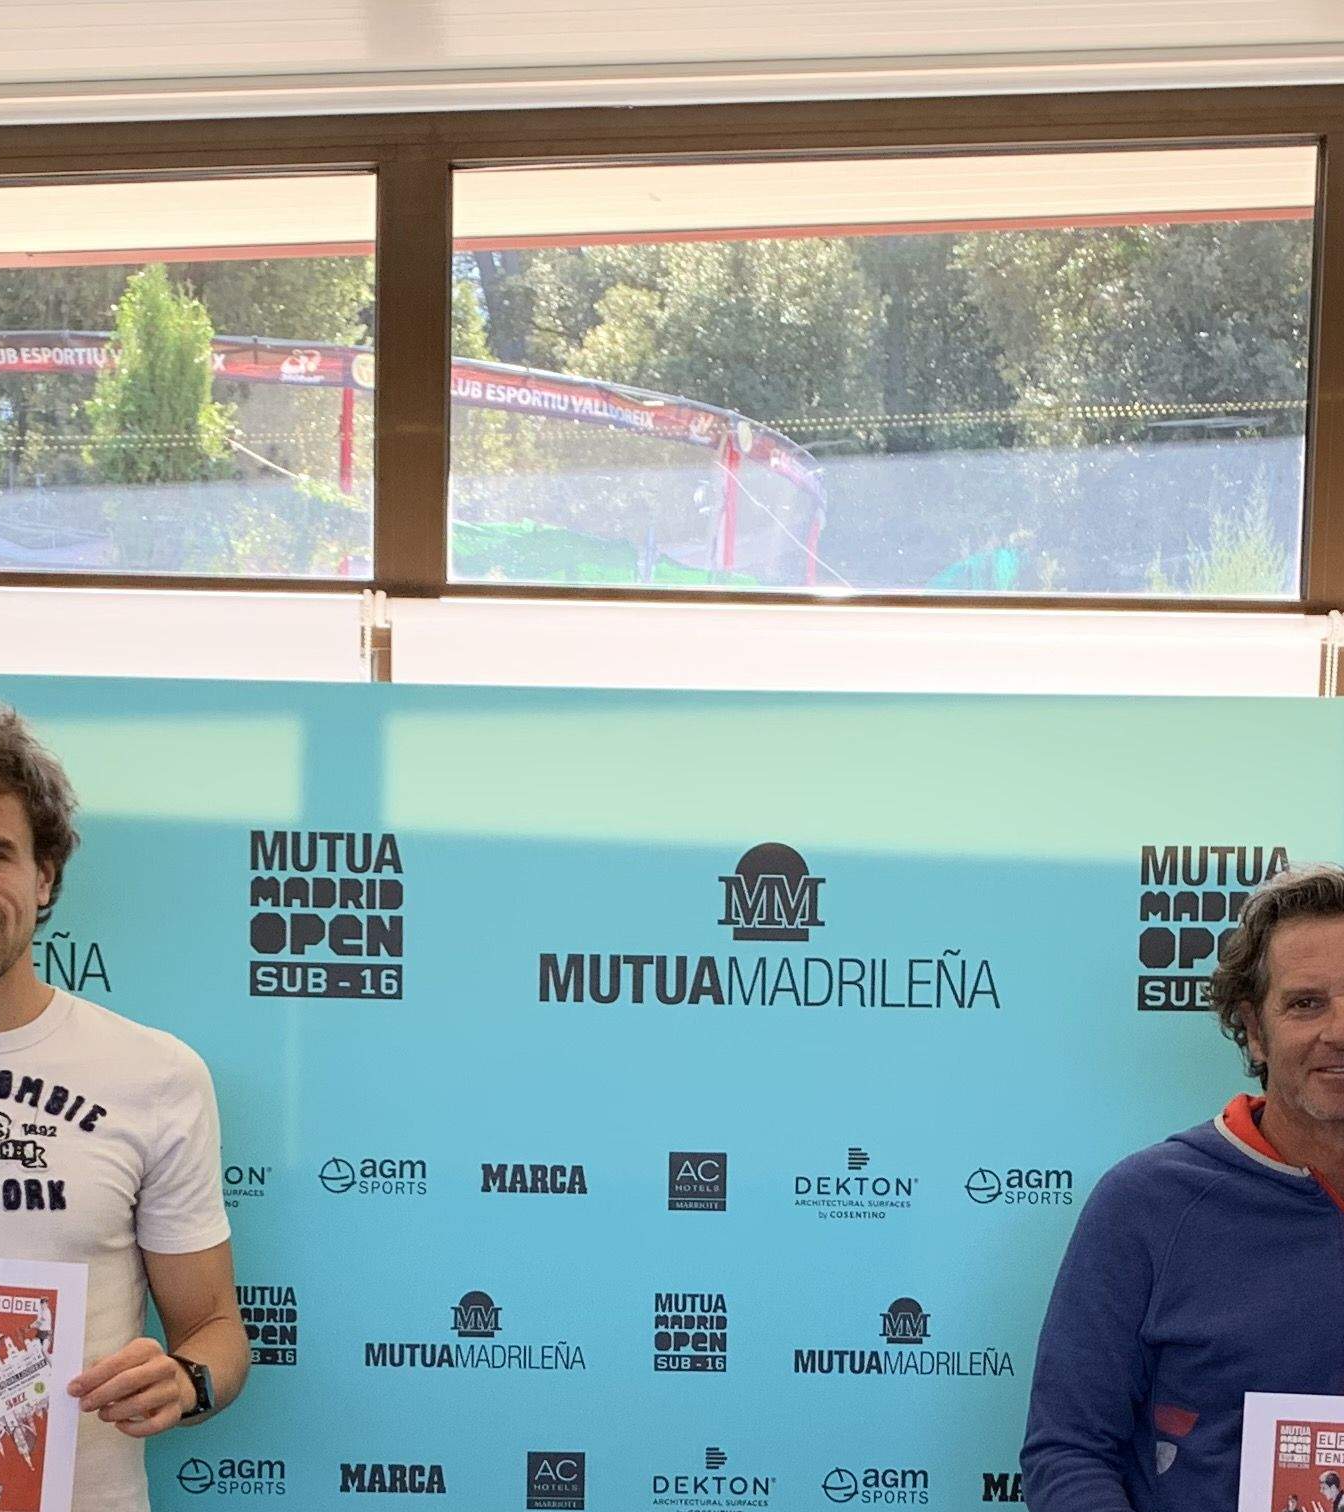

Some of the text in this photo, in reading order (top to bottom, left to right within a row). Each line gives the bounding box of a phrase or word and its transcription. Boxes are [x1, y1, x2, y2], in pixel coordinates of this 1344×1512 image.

[451, 379, 483, 401] LUB
[486, 382, 570, 413] ESPORTIU
[250, 830, 404, 875] MUTUA
[1140, 846, 1290, 886] MUTUA
[250, 876, 404, 911] MADRID
[250, 912, 404, 958] OPEN
[538, 949, 1001, 1010] MUTUAMADRILEÑA
[481, 1163, 588, 1195] MARCA
[674, 1159, 721, 1183] AC
[358, 1181, 428, 1196] SPORTS
[795, 1175, 912, 1197] DEKTON
[1004, 1191, 1074, 1205] SPORTS
[14, 1298, 39, 1313] DEL
[654, 1293, 727, 1314] MUTUA
[654, 1315, 727, 1330] MADRID
[654, 1331, 727, 1353] OPEN
[364, 1341, 587, 1370] MUTUAMADRILEÑA
[793, 1347, 1015, 1377] MUTUAMADRILEÑA
[1318, 1434, 1334, 1446] EL
[340, 1463, 447, 1494] MARCA
[533, 1459, 579, 1482] AC
[217, 1481, 287, 1495] SPORTS
[653, 1475, 770, 1496] DEKTON
[860, 1490, 930, 1505] SPORTS
